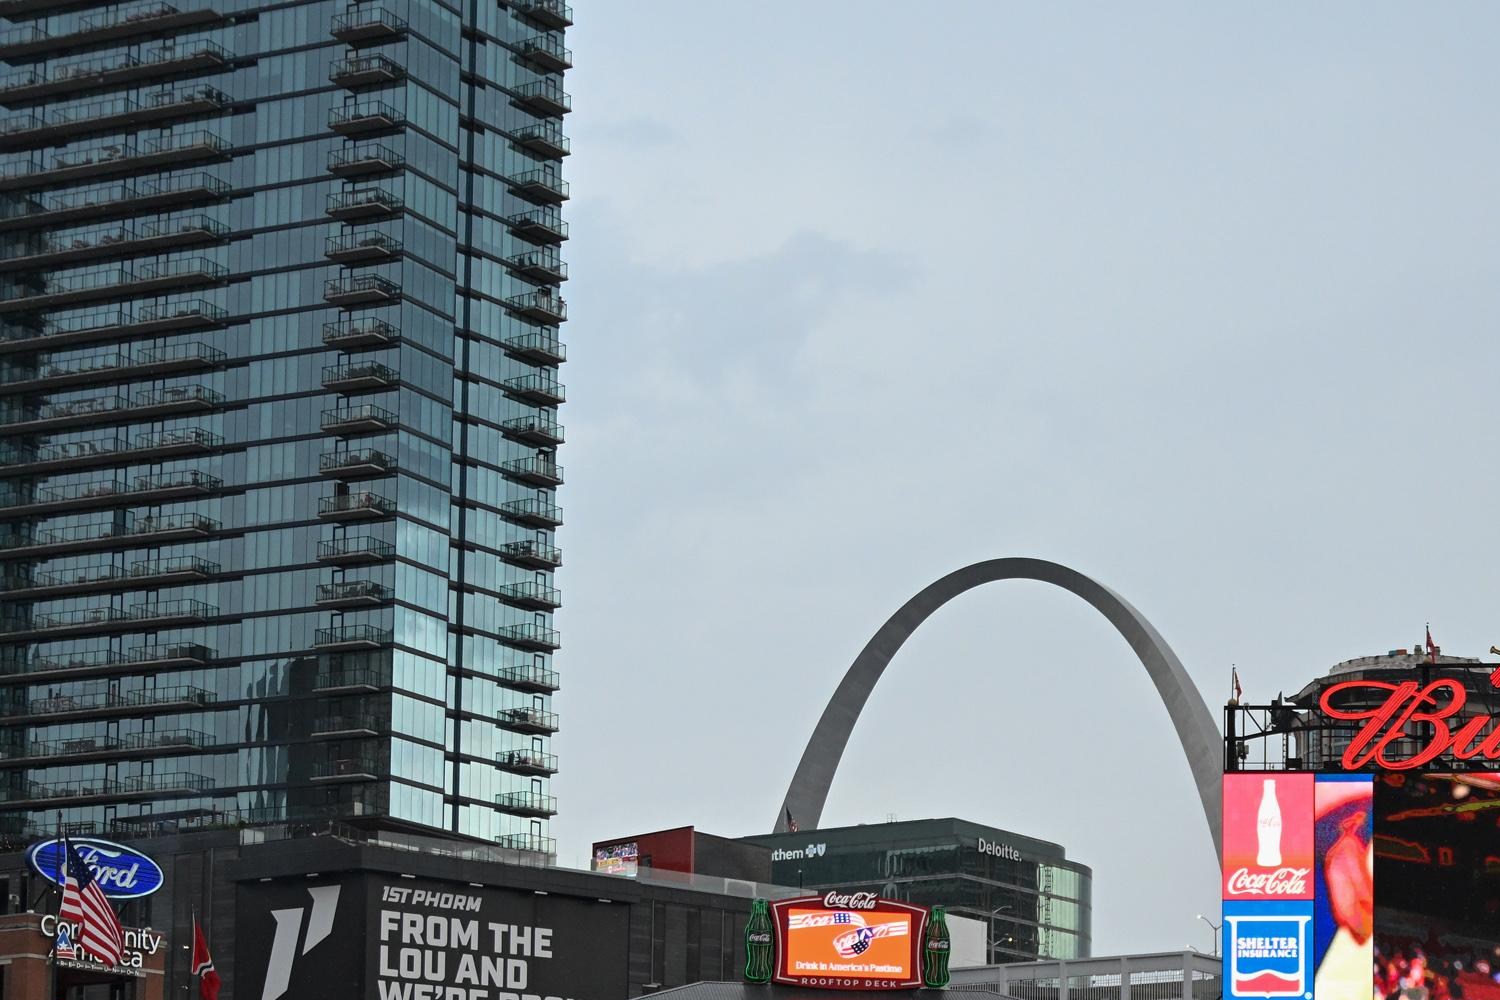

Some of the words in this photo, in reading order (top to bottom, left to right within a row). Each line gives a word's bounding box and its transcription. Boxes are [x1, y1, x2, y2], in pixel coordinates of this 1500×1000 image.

[978, 837, 1022, 862] Deloitte.
[1228, 867, 1311, 895] Coca-Cola
[382, 886, 411, 904] 1ST
[412, 891, 483, 913] PHORM
[823, 891, 878, 909] Coca-Cola
[380, 909, 479, 950] FROM
[488, 922, 553, 958] THE
[1237, 937, 1297, 950] SHELTER
[1238, 950, 1298, 958] INSURANCE
[379, 945, 446, 981] LOU
[455, 954, 528, 990] AND
[795, 961, 818, 971] Drink
[828, 962, 868, 973] America's
[869, 964, 903, 974] Pastime
[801, 977, 860, 987] ROOFTOP
[865, 980, 897, 988] DECK
